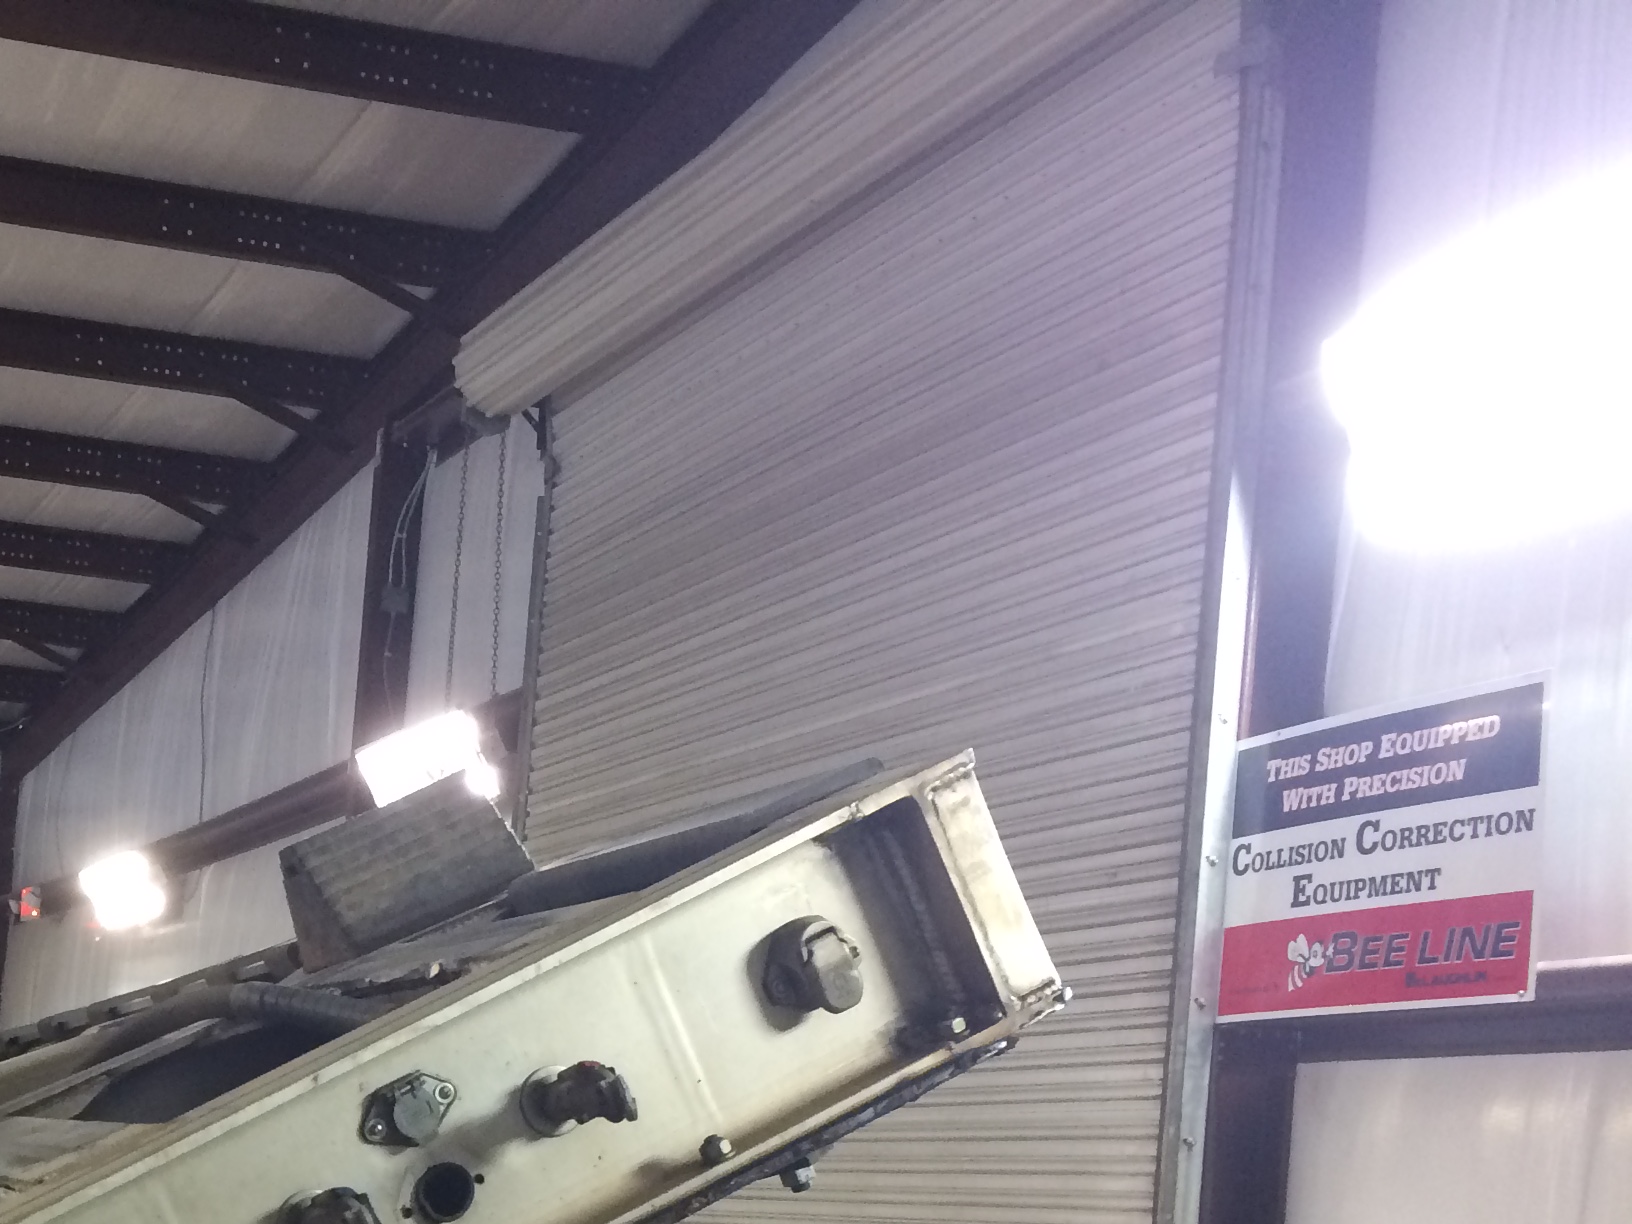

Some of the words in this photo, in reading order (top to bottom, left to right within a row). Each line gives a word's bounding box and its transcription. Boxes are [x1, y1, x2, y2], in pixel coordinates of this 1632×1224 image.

[1267, 754, 1311, 782] THIS
[1315, 742, 1373, 772] SHOP
[1378, 715, 1501, 759] EQUIPPED
[1282, 783, 1337, 812] WITH
[1342, 759, 1467, 801] PRECISION
[1232, 837, 1346, 876] COLLISION
[1356, 808, 1536, 855] CORRECTION
[1290, 867, 1441, 908] EQUIPMENT
[1324, 930, 1411, 974] BEE
[1415, 921, 1521, 967] LINE
